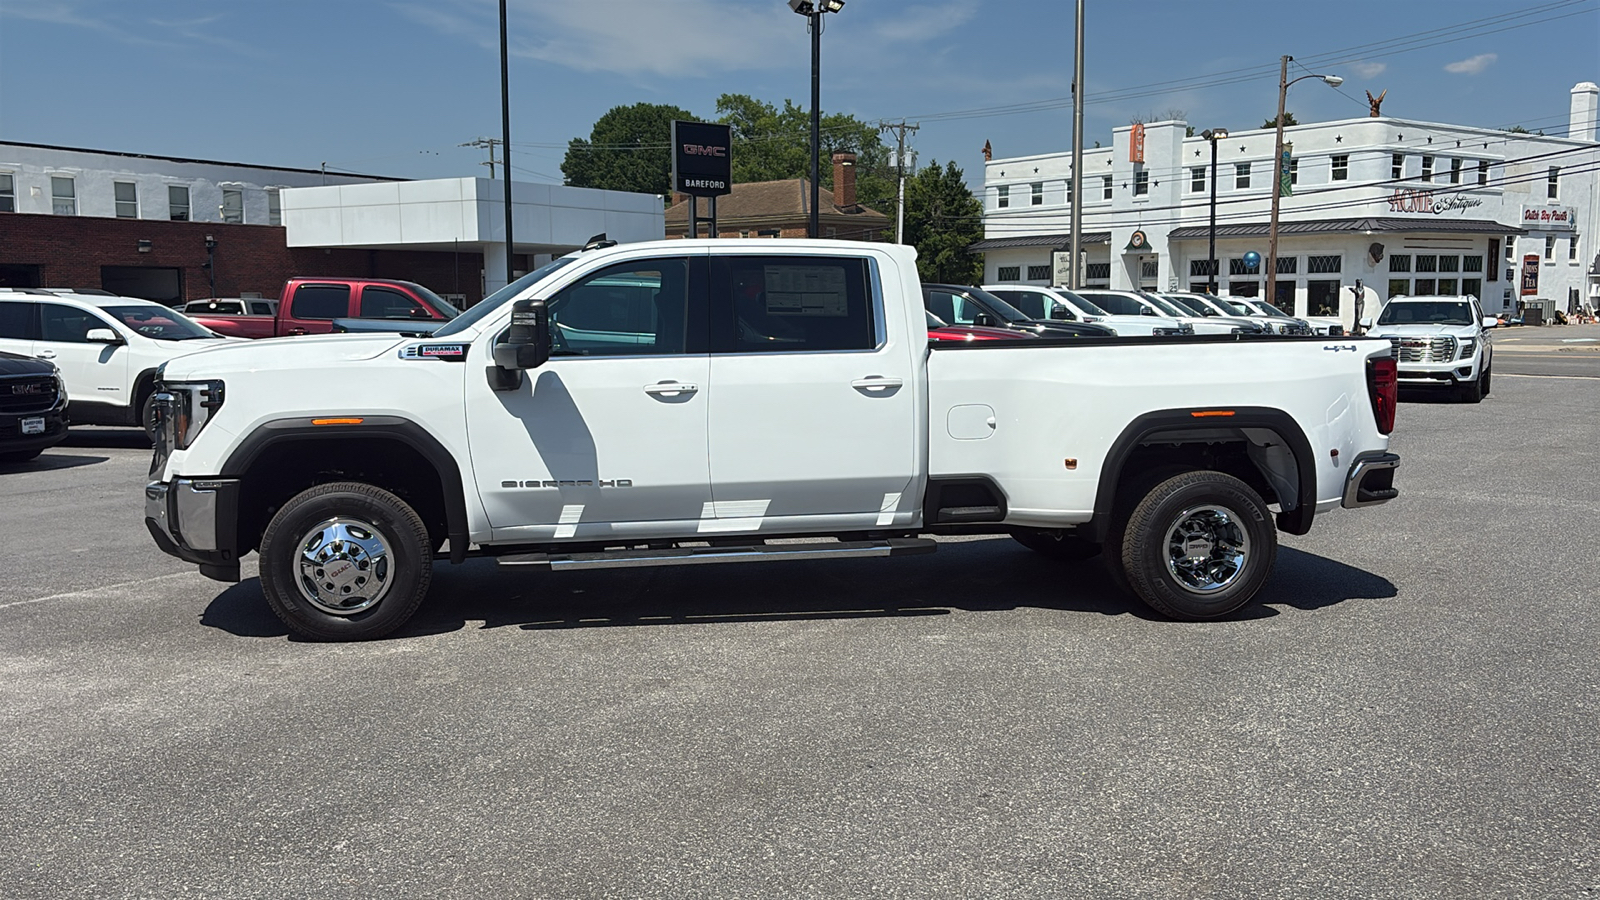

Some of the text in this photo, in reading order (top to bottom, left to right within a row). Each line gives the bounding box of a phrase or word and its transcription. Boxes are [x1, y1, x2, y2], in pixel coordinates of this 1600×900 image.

[683, 144, 726, 157] GMC
[685, 179, 725, 189] BAREFORD
[1388, 188, 1434, 213] ACME
[1524, 209, 1568, 223] Dutch Boy Paints
[1525, 278, 1536, 288] TEA
[501, 480, 593, 488] SIERRA
[331, 562, 352, 578] GMC
